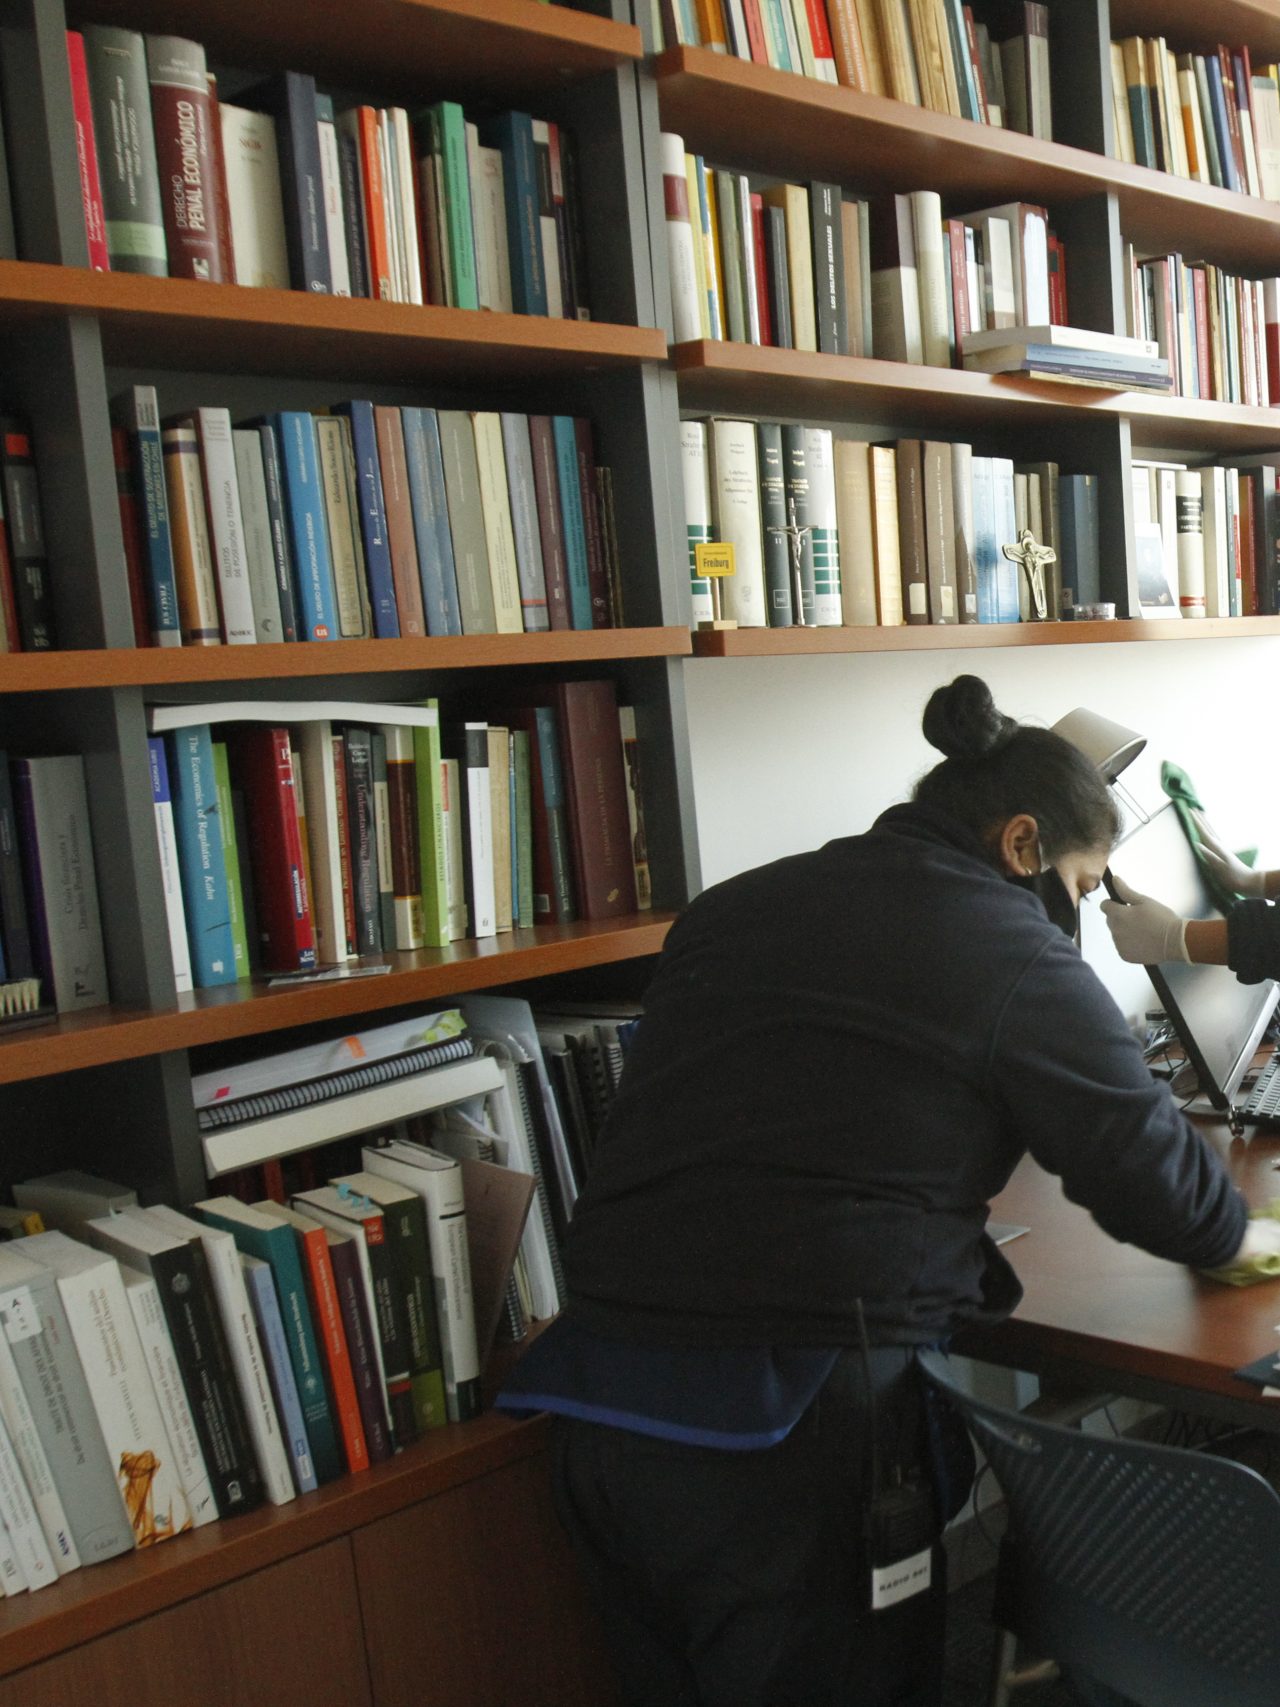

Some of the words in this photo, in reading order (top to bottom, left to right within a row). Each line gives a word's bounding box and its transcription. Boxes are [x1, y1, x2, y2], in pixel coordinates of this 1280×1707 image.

[170, 99, 201, 187] ECONÓMICO
[171, 174, 187, 228] DERECHO
[185, 187, 206, 232] PENAL
[703, 558, 729, 569] Freiburg
[189, 756, 205, 807] Economics
[196, 820, 212, 868] Regulation
[354, 782, 372, 856] Understanding
[360, 858, 375, 912] Regulation
